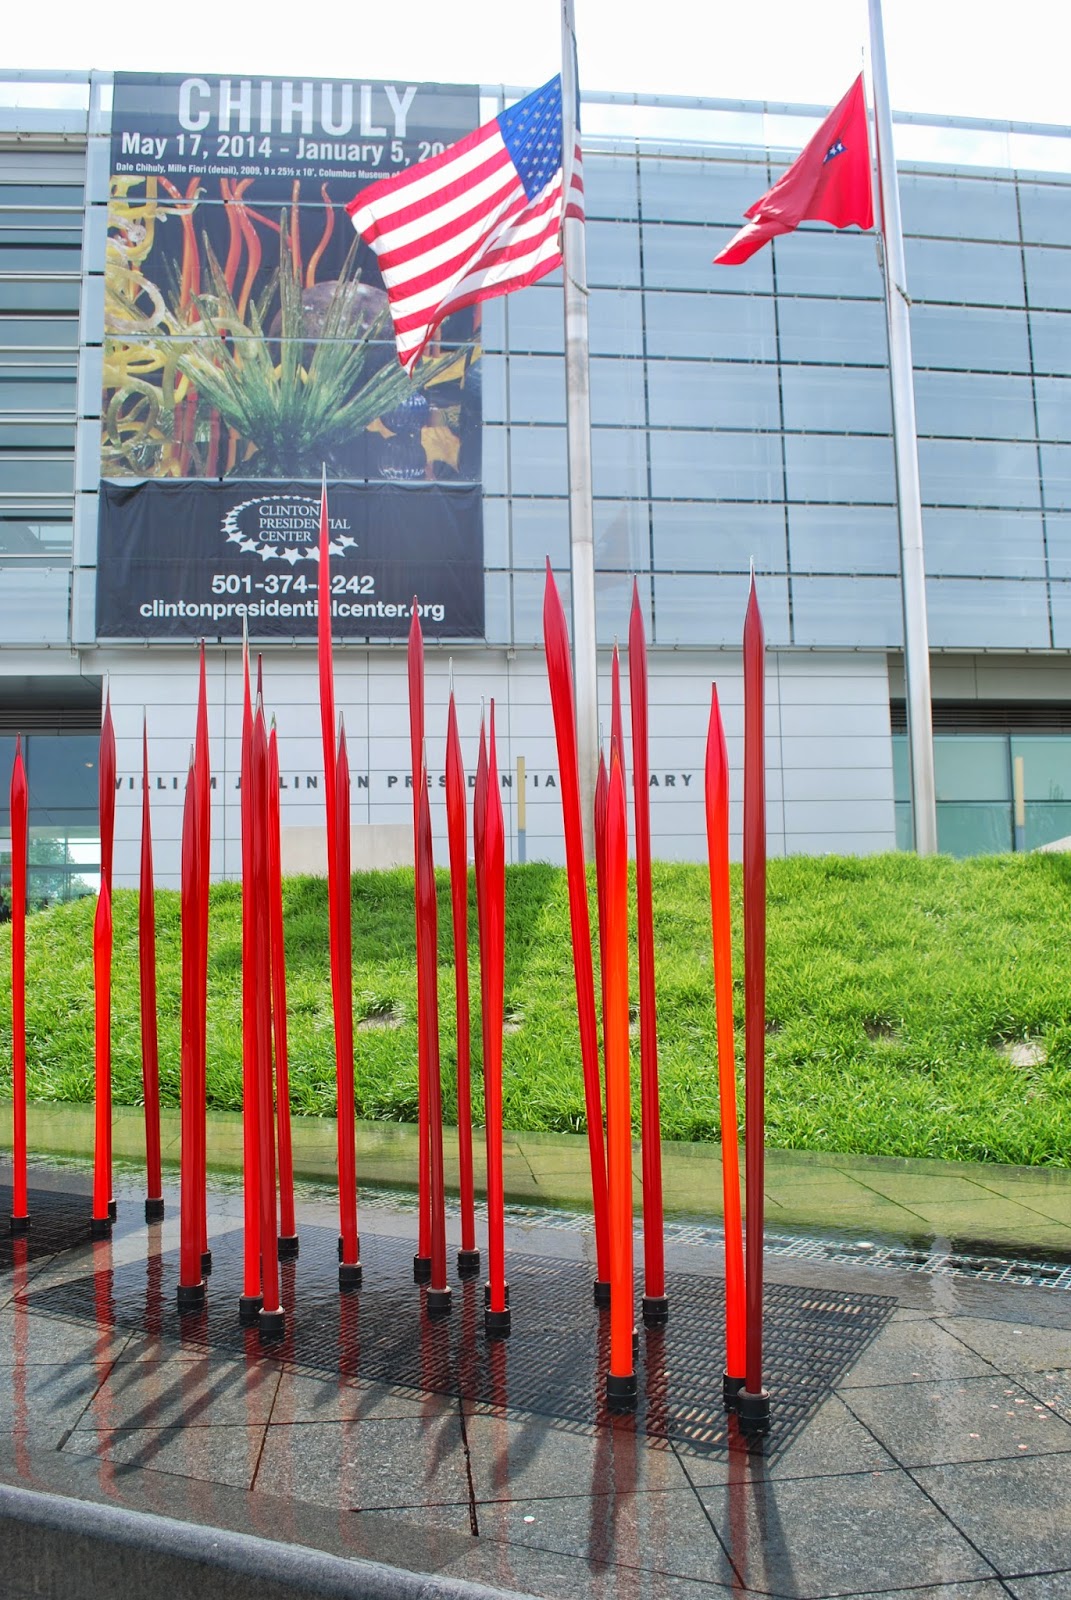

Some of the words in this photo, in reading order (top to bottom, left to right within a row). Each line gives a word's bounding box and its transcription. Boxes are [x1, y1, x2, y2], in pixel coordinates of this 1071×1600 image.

[178, 77, 418, 139] CHIHULY
[121, 132, 168, 159] May
[176, 133, 209, 160] 17,
[216, 135, 273, 159] 2014
[296, 137, 383, 167] January
[391, 140, 411, 167] 5,
[116, 162, 134, 172] Dale
[135, 163, 166, 174] Chihuly,
[167, 164, 187, 173] Mille
[188, 164, 207, 174] Fiori
[208, 164, 239, 175] (detail),
[240, 165, 262, 176] 2009,
[264, 166, 270, 176] 9
[271, 168, 276, 176] x
[296, 168, 301, 177] x
[319, 168, 357, 179] Columbus
[358, 169, 390, 180] Museum
[258, 504, 321, 517] CLINTON
[259, 517, 352, 530] PRESIDENIAL
[258, 530, 313, 543] CENTER
[211, 574, 375, 595] 501-374-242
[139, 599, 446, 622] clintonpresidentilcenter.org
